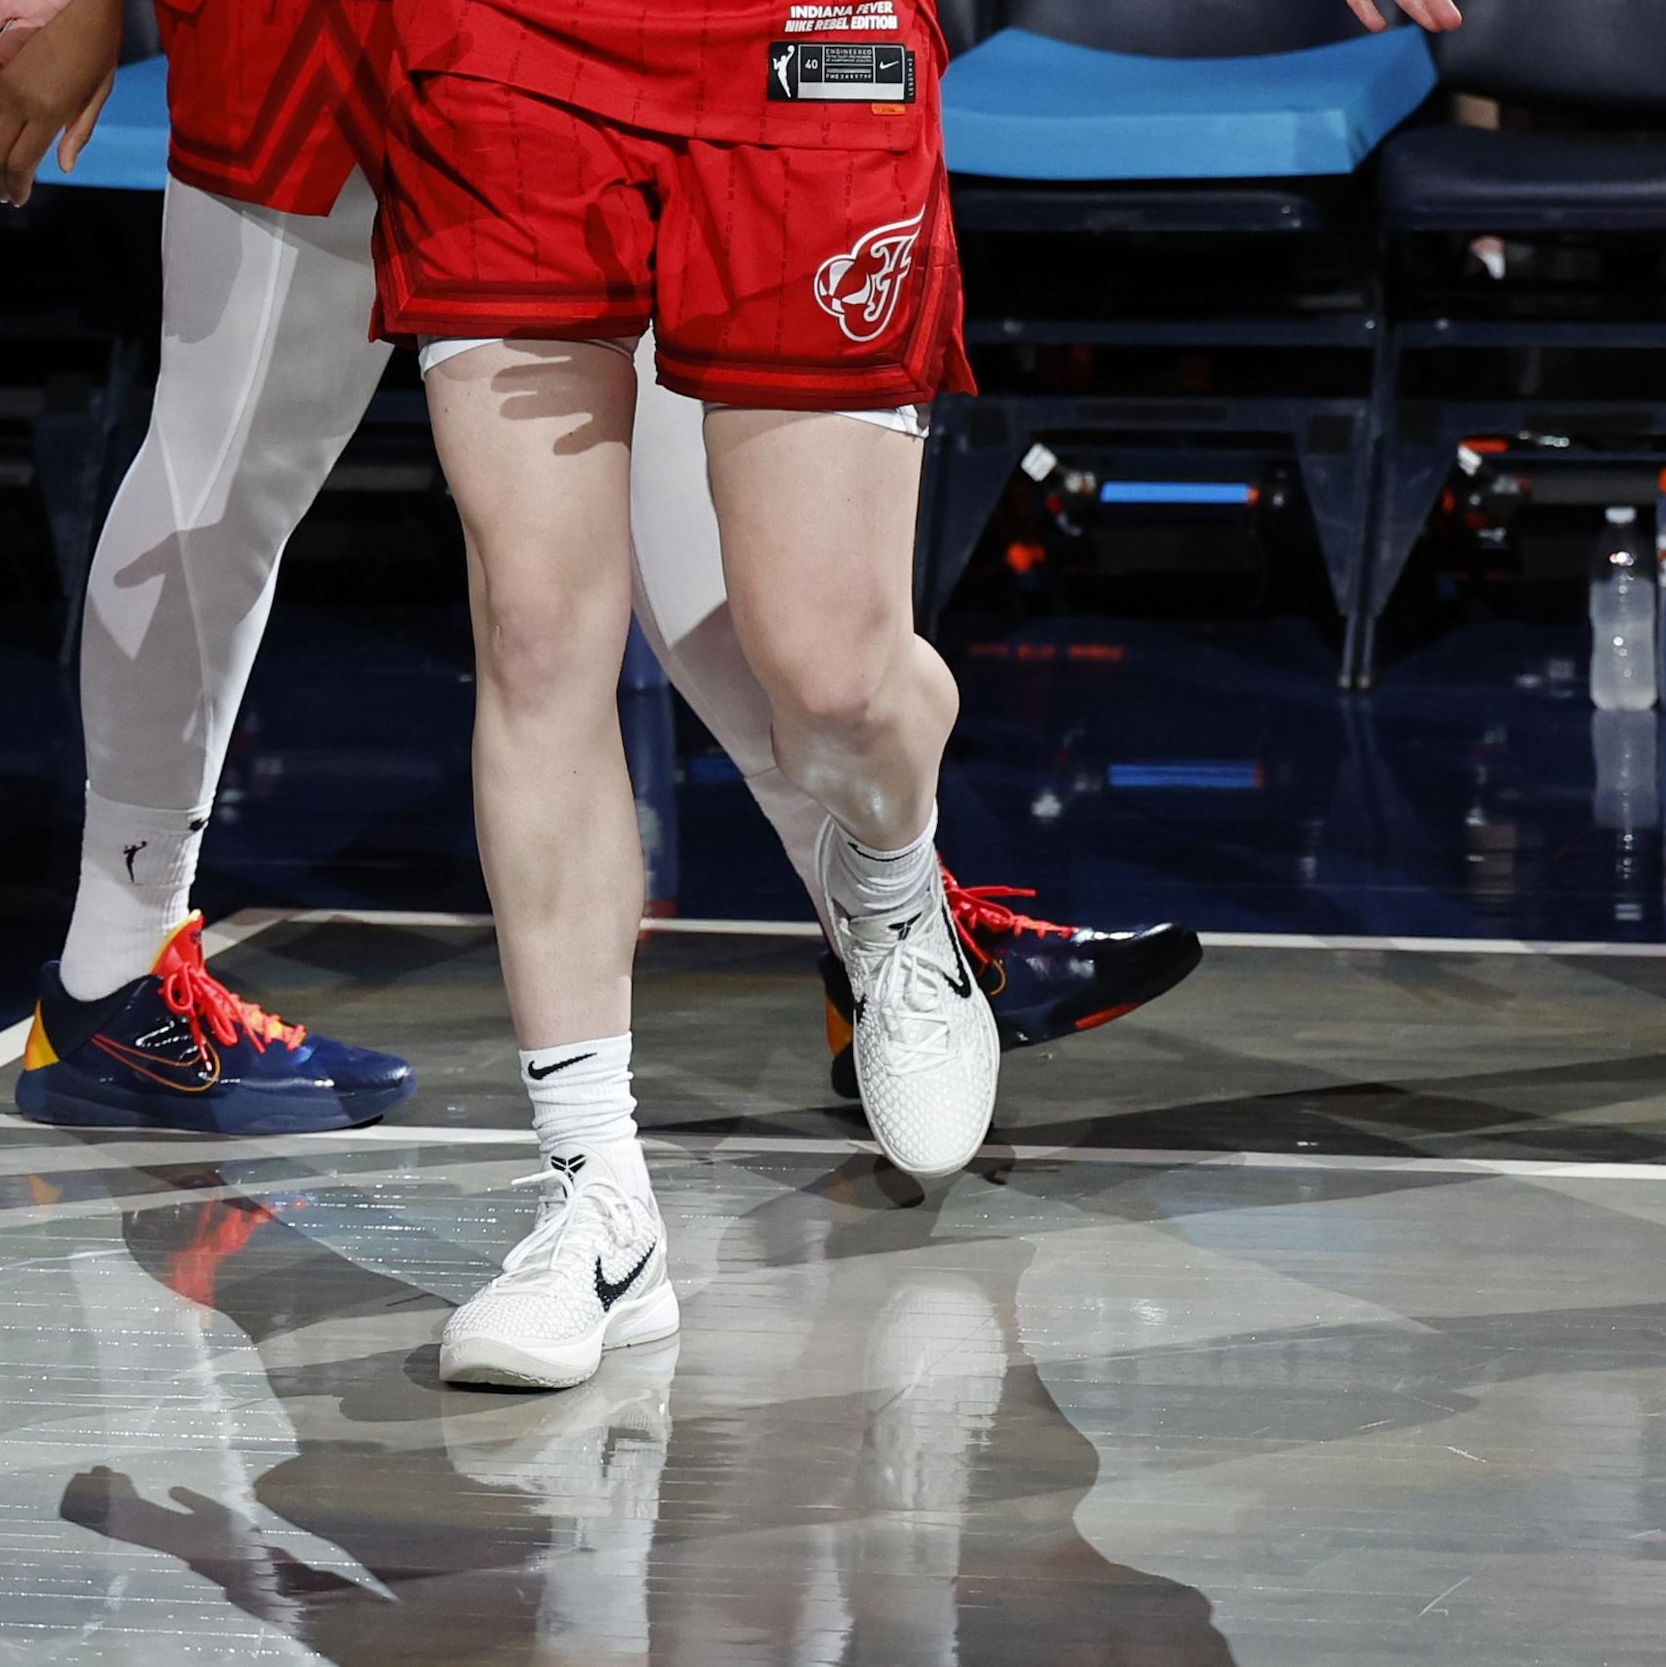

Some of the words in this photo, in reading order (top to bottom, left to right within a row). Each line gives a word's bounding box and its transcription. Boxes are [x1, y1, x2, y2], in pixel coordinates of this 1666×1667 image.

[790, 5, 853, 19] INDIANA
[856, 1, 893, 14] FEVER
[785, 20, 814, 33] NIKE
[814, 17, 849, 32] REBEL
[850, 15, 898, 30] EDITION
[804, 58, 819, 70] 40
